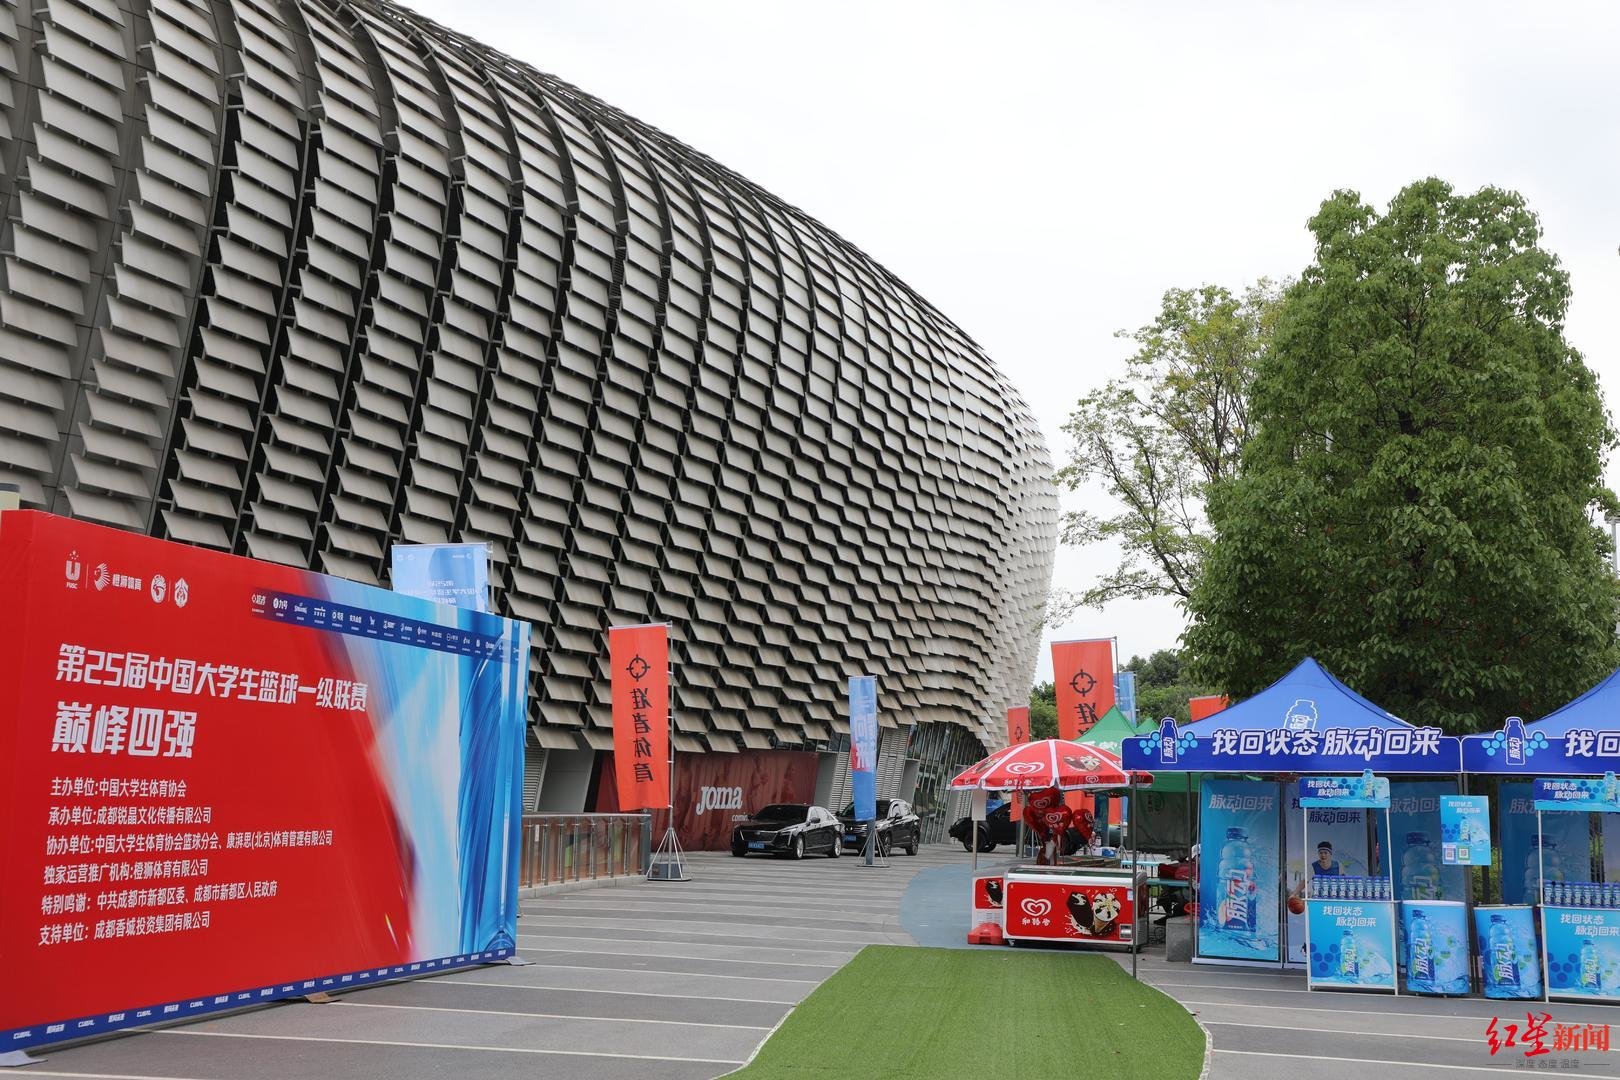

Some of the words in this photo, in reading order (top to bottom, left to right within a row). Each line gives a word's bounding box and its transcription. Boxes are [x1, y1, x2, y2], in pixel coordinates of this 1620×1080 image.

[56, 643, 369, 712] 第25届中国大学生篮球一级联赛
[51, 701, 198, 759] 巅峰四强
[1212, 730, 1319, 757] 找回状态
[1321, 729, 1441, 762] 脉动回来
[50, 776, 187, 798] 主办单位:中国大学生体育协会
[1208, 794, 1274, 813] 脉动回来
[1309, 811, 1361, 826] 脉动回来
[1323, 905, 1363, 916] 找回状态
[1560, 913, 1605, 925] 找回状态
[1336, 917, 1377, 929] 脉动回来
[1574, 926, 1620, 938] 脉动回来
